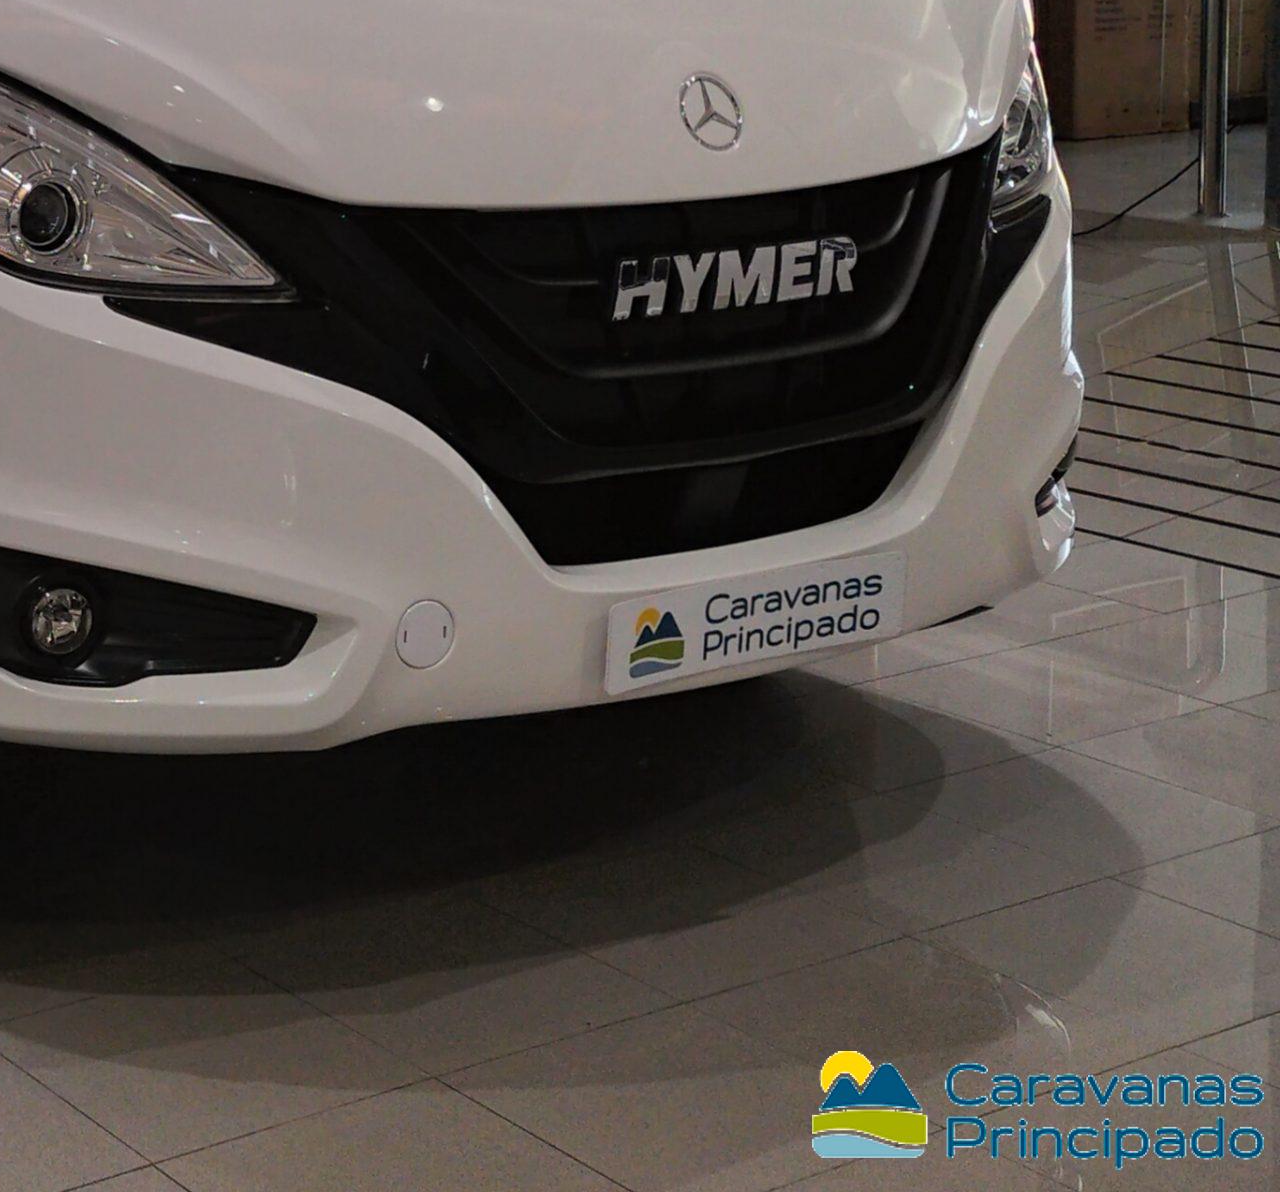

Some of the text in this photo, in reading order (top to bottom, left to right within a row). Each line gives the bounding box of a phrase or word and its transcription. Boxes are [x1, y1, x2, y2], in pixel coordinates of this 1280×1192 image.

[611, 236, 858, 321] HYMER
[705, 574, 883, 625] Caravanas
[703, 605, 880, 660] Principado
